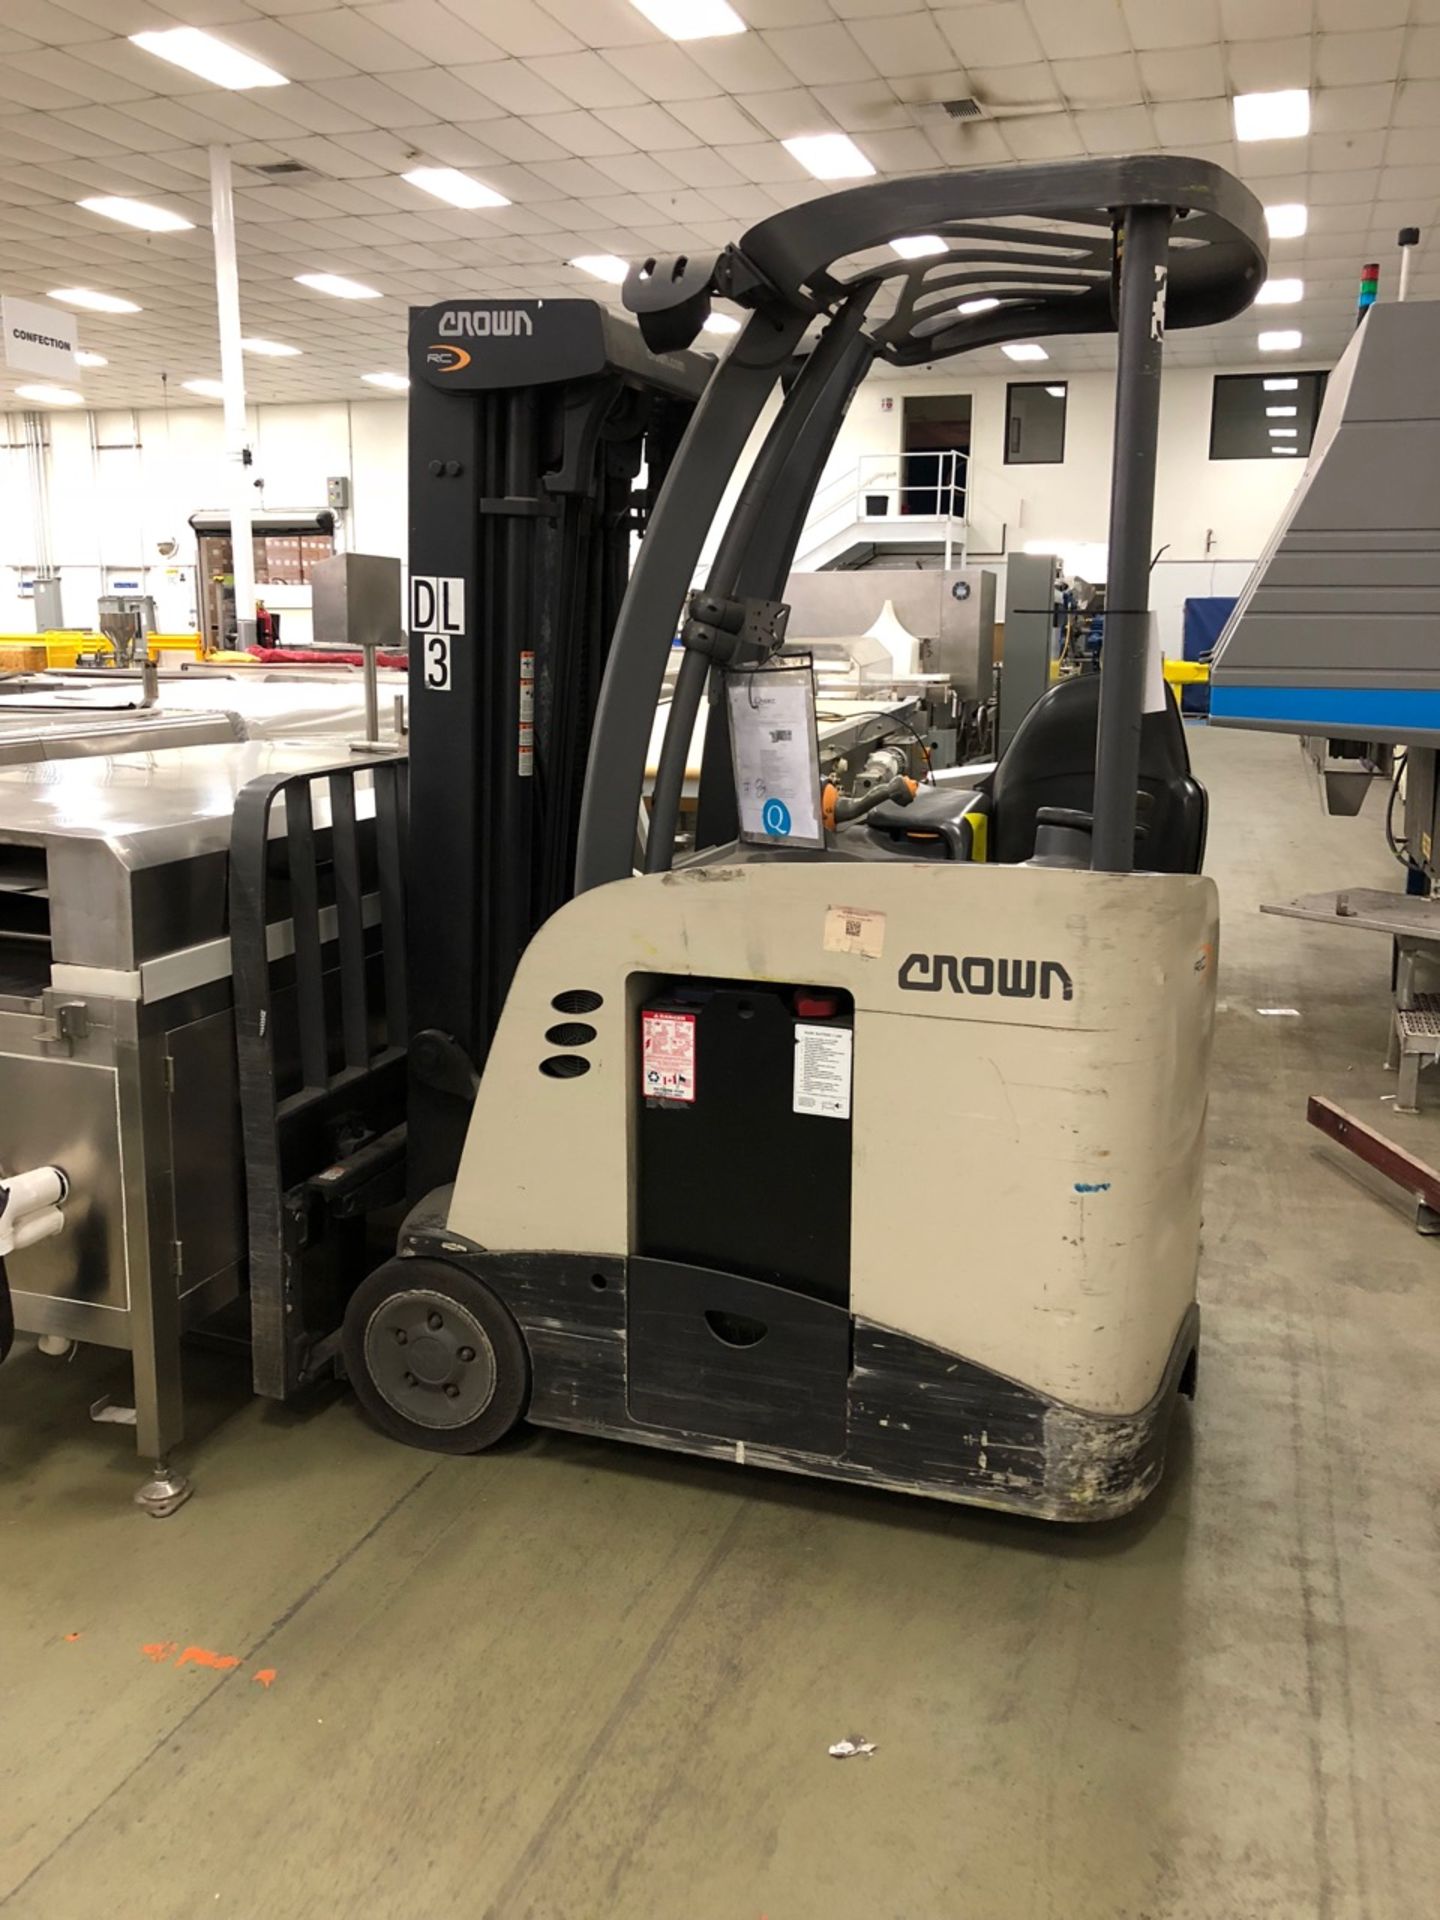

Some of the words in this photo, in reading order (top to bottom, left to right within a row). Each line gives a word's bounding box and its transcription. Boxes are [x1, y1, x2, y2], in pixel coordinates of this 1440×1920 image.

[439, 310, 533, 336] CROWN
[13, 328, 71, 351] CONFECTION
[427, 353, 452, 363] RC
[428, 638, 448, 687] 3
[767, 804, 787, 834] Q
[898, 953, 1073, 1001] CROWN
